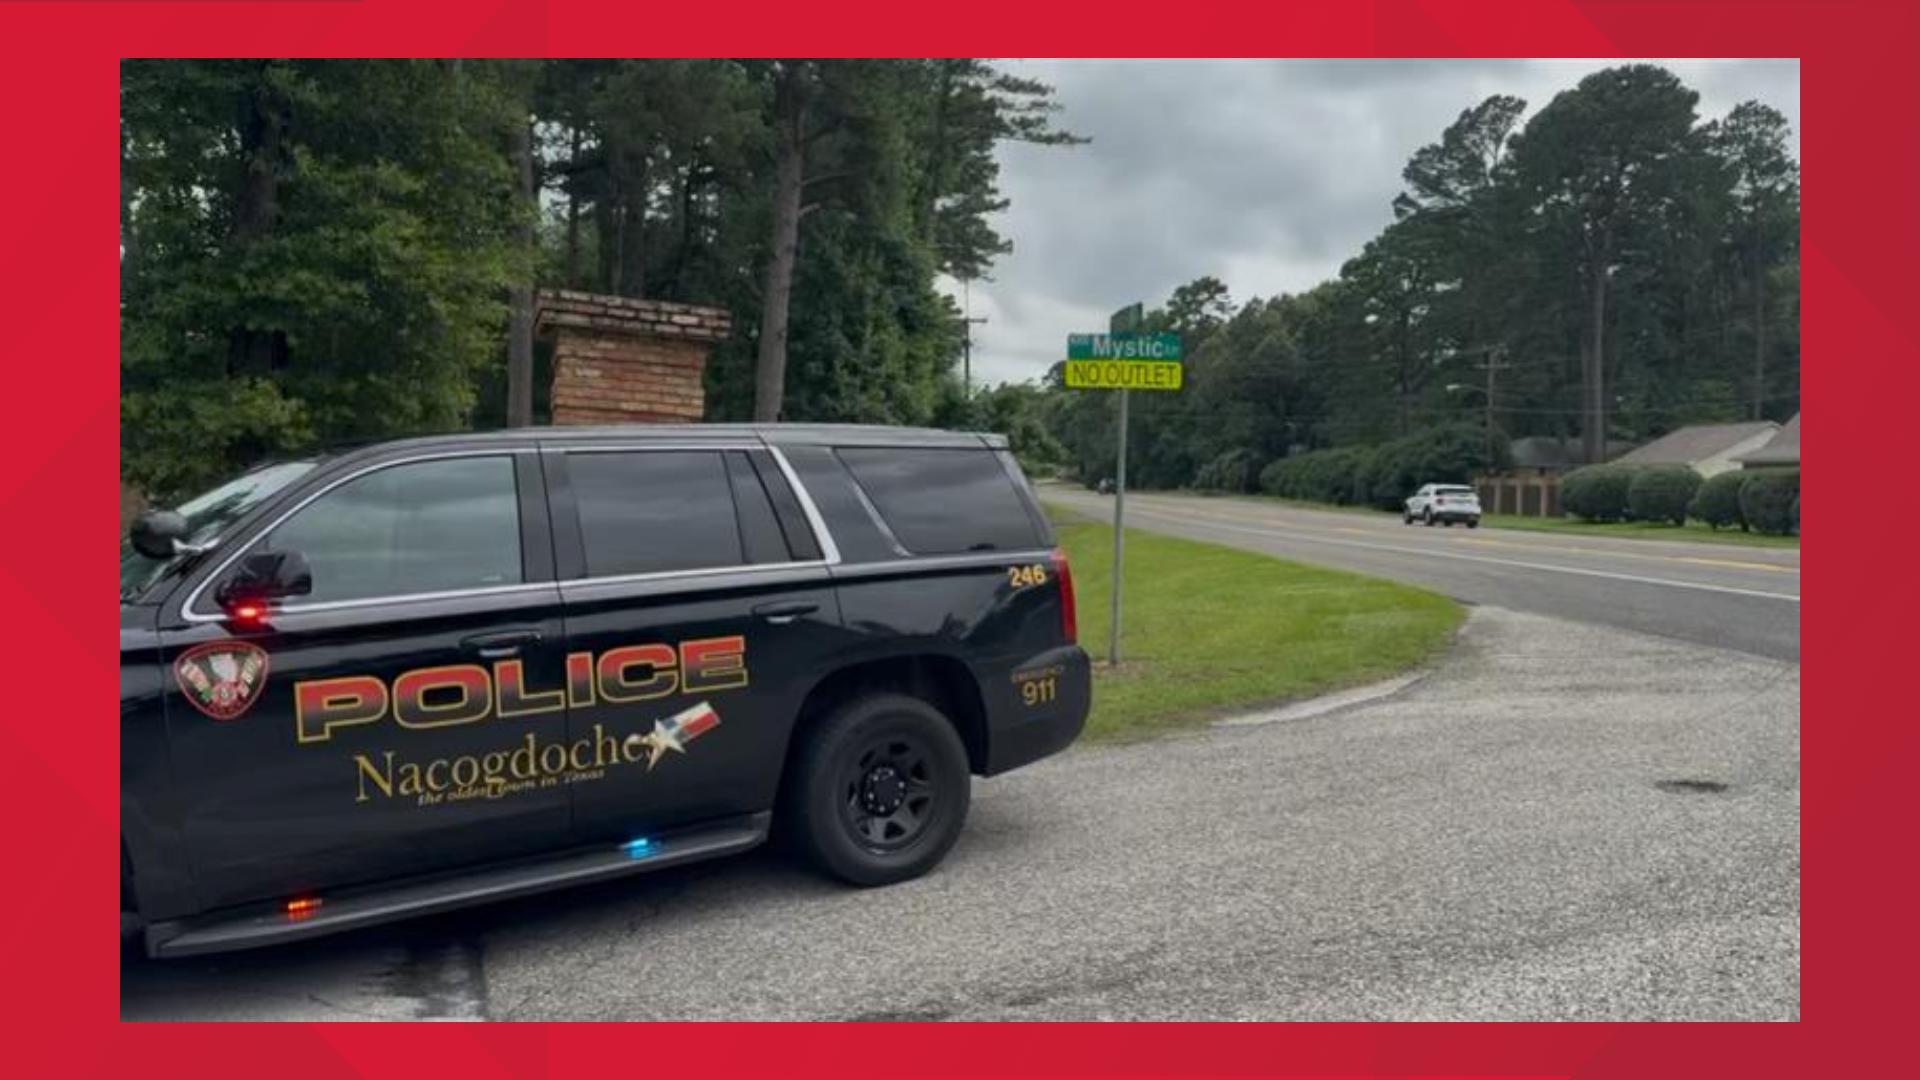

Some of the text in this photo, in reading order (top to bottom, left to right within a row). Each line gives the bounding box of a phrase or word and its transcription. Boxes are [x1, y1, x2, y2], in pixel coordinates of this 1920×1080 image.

[1092, 334, 1163, 360] Mystic
[1073, 362, 1178, 387] NO OUTLET
[1008, 564, 1046, 587] 246
[295, 635, 748, 743] POLICE
[1022, 677, 1057, 706] 911
